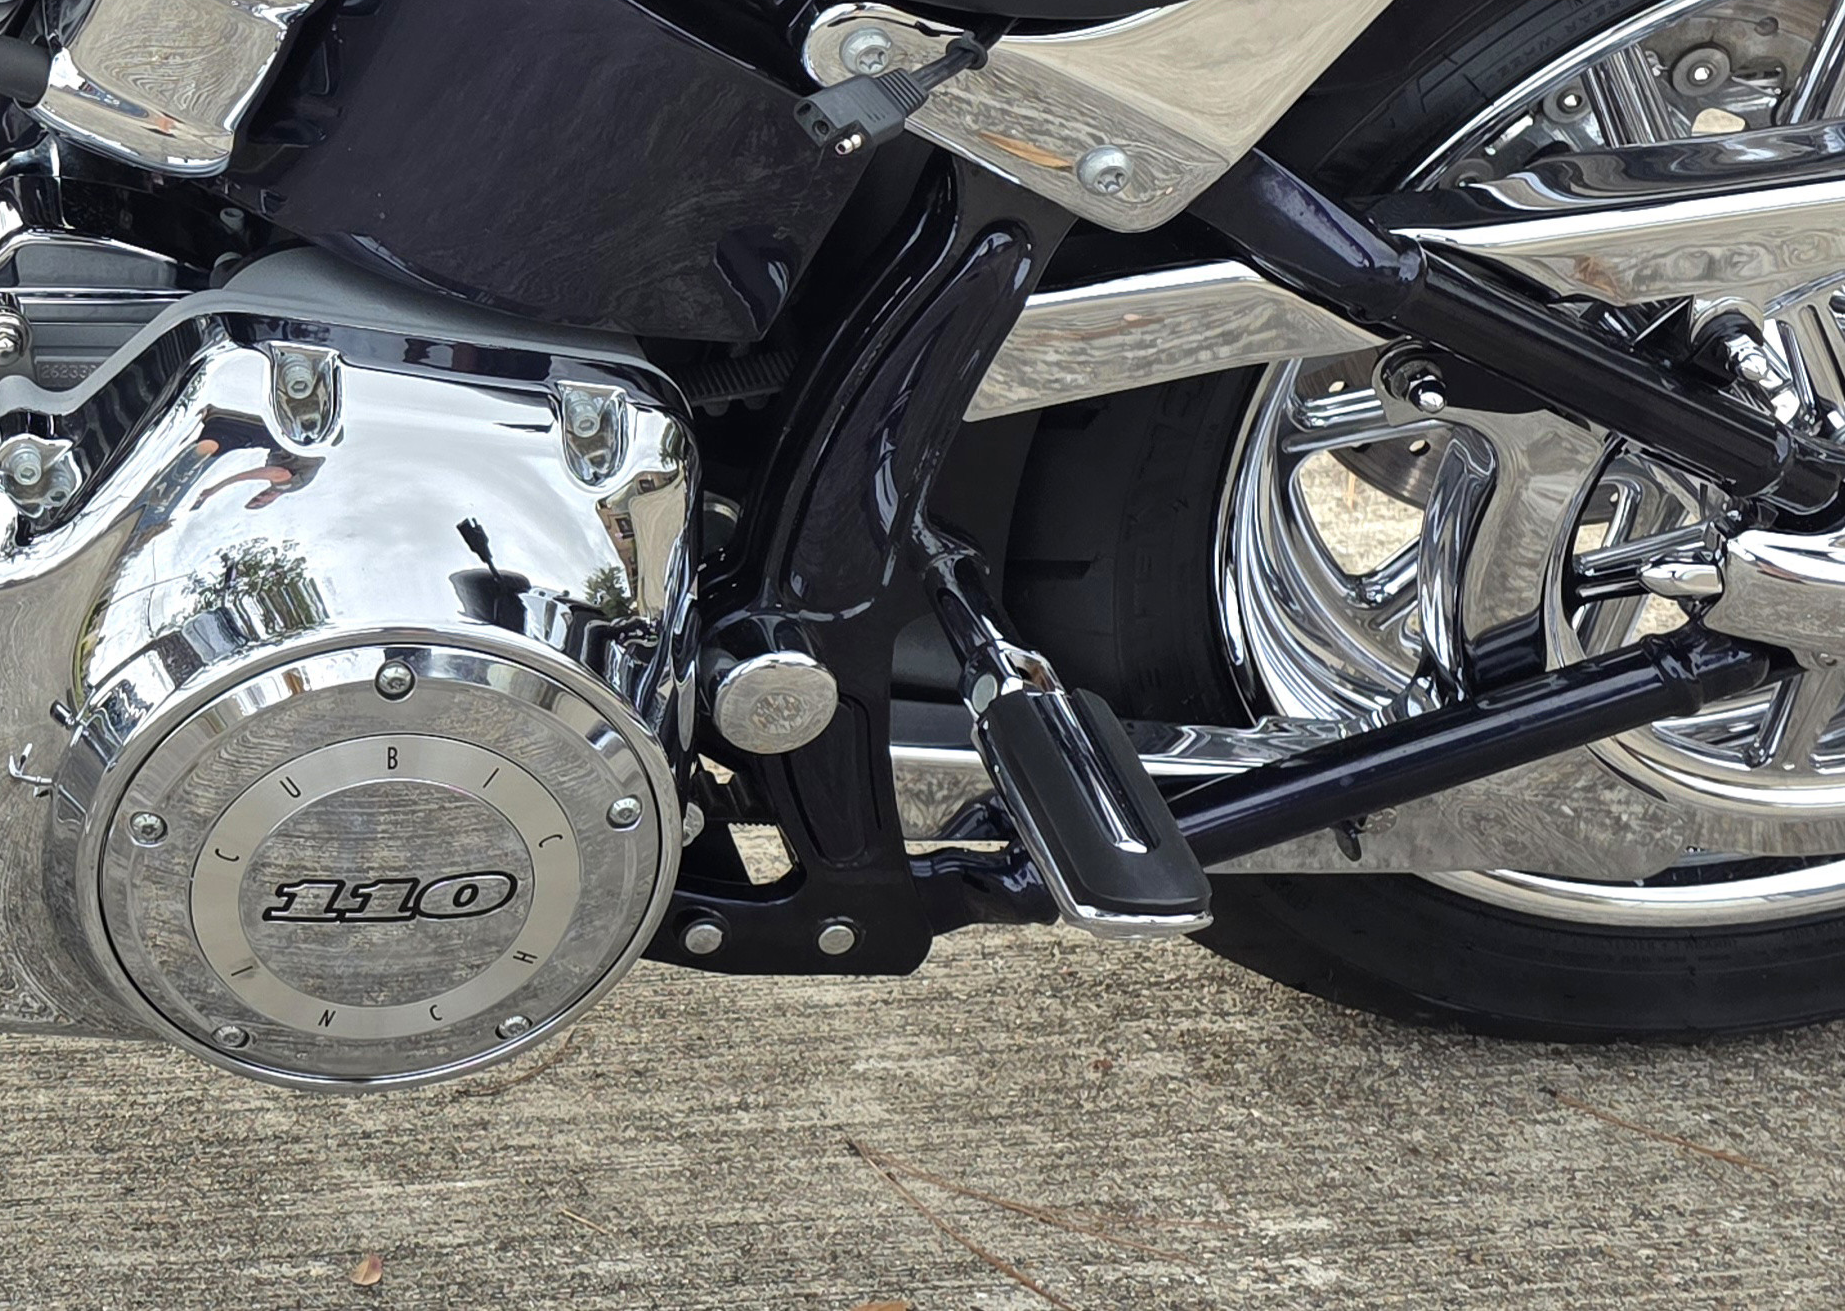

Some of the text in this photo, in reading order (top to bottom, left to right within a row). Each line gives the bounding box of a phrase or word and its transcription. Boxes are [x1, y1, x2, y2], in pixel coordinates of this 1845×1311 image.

[214, 746, 564, 864] CUBIC
[262, 870, 518, 924] 110
[230, 949, 539, 1029] INCH
